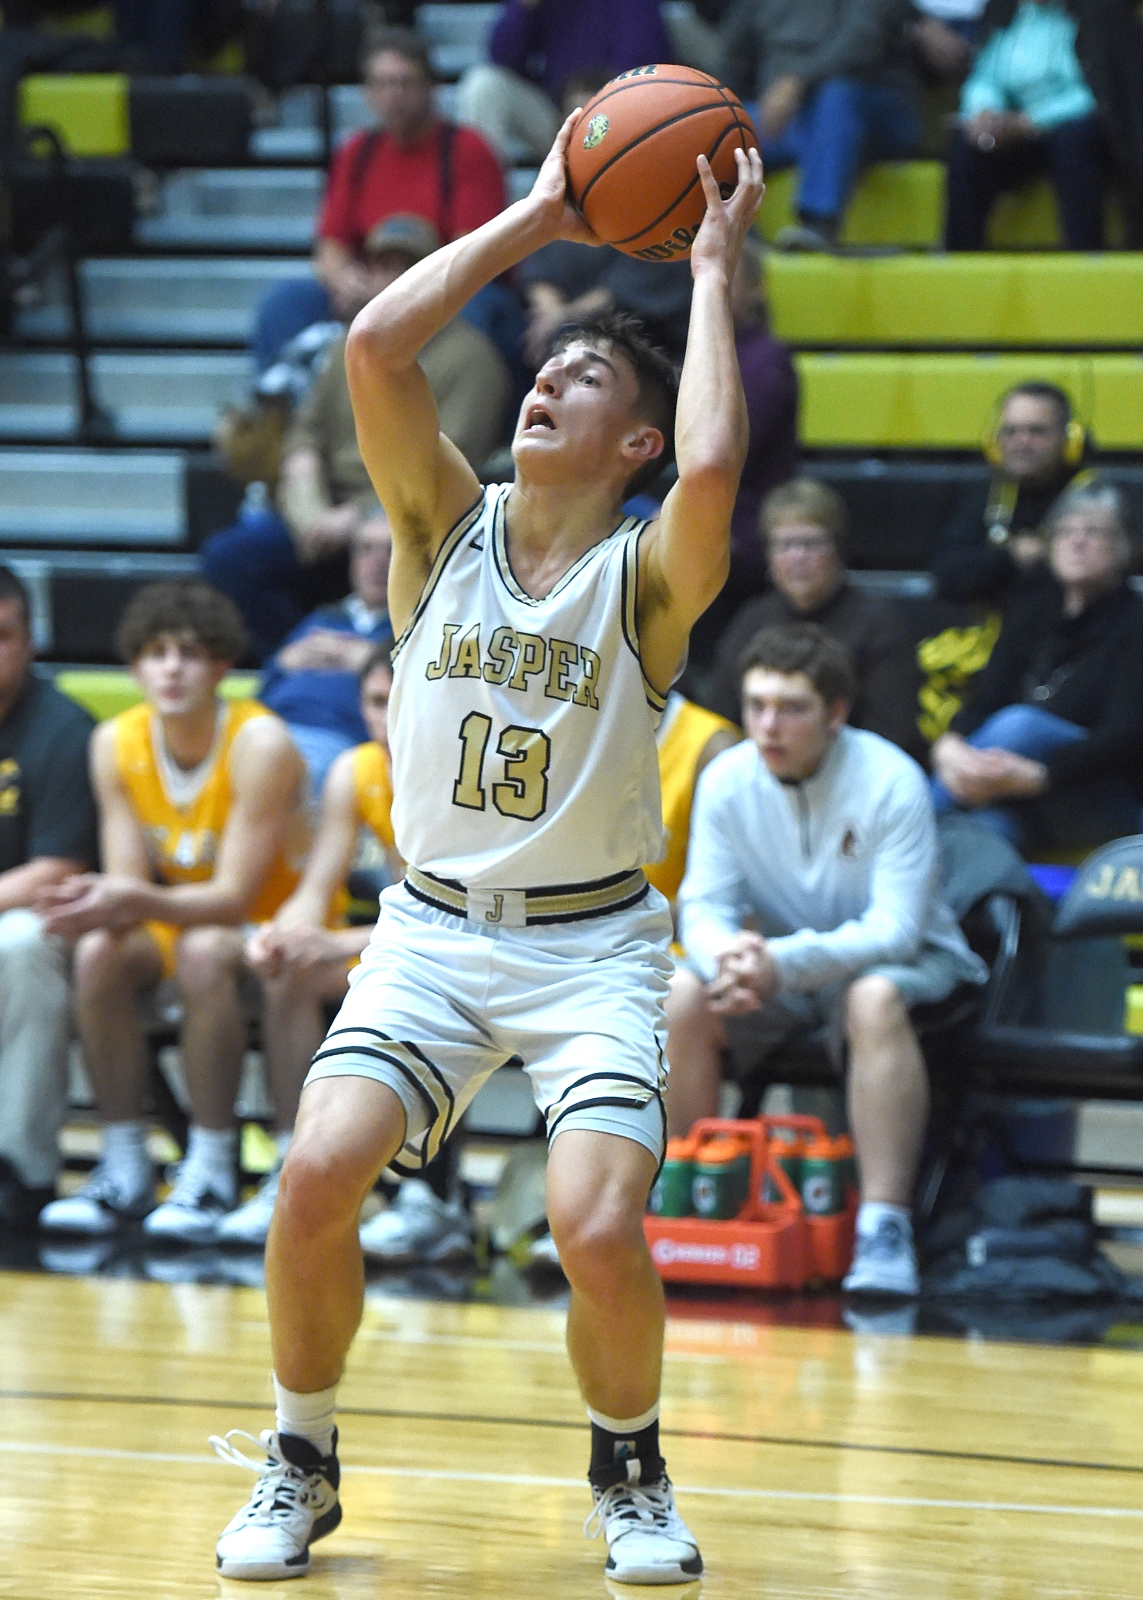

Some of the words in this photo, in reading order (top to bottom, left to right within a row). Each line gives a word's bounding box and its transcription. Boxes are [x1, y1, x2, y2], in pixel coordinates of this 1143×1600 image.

[633, 225, 700, 261] Wil
[425, 622, 601, 710] JASPER
[452, 710, 551, 822] 13
[1085, 864, 1143, 902] JA
[485, 894, 504, 923] J
